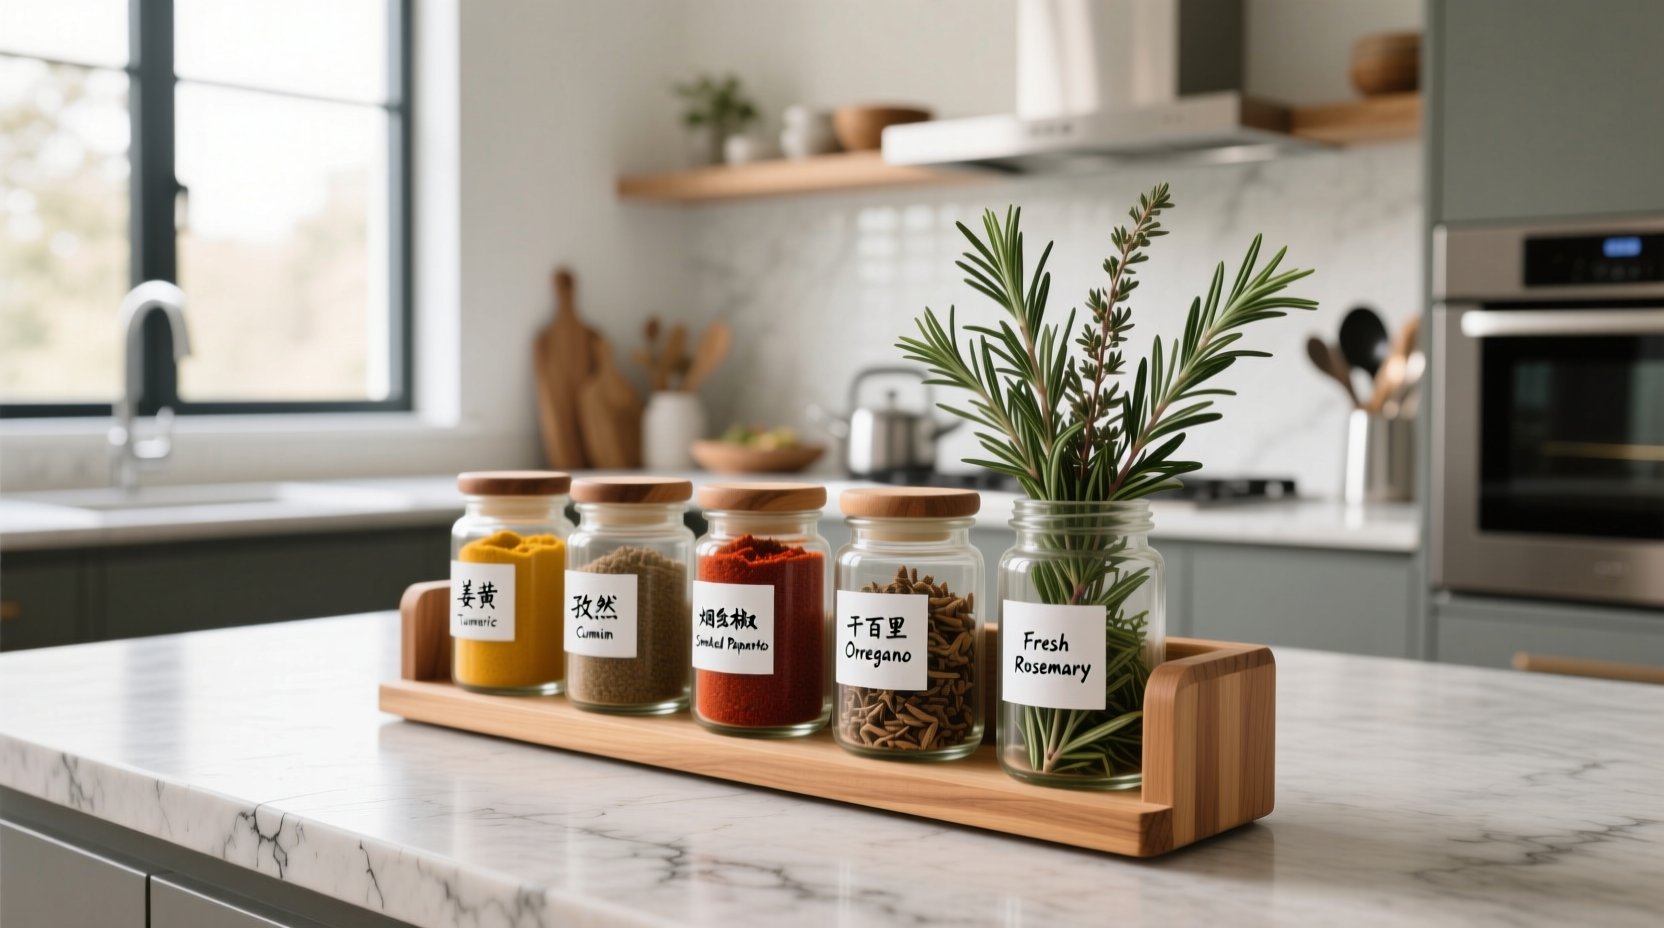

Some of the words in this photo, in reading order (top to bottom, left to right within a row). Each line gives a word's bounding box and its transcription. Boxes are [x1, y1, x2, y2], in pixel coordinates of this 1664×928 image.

[457, 579, 498, 610] 姜黄
[571, 594, 618, 620] 孜然
[845, 641, 912, 668] Orregano
[1024, 631, 1069, 652] Fresh
[1015, 655, 1091, 684] Rosemary
